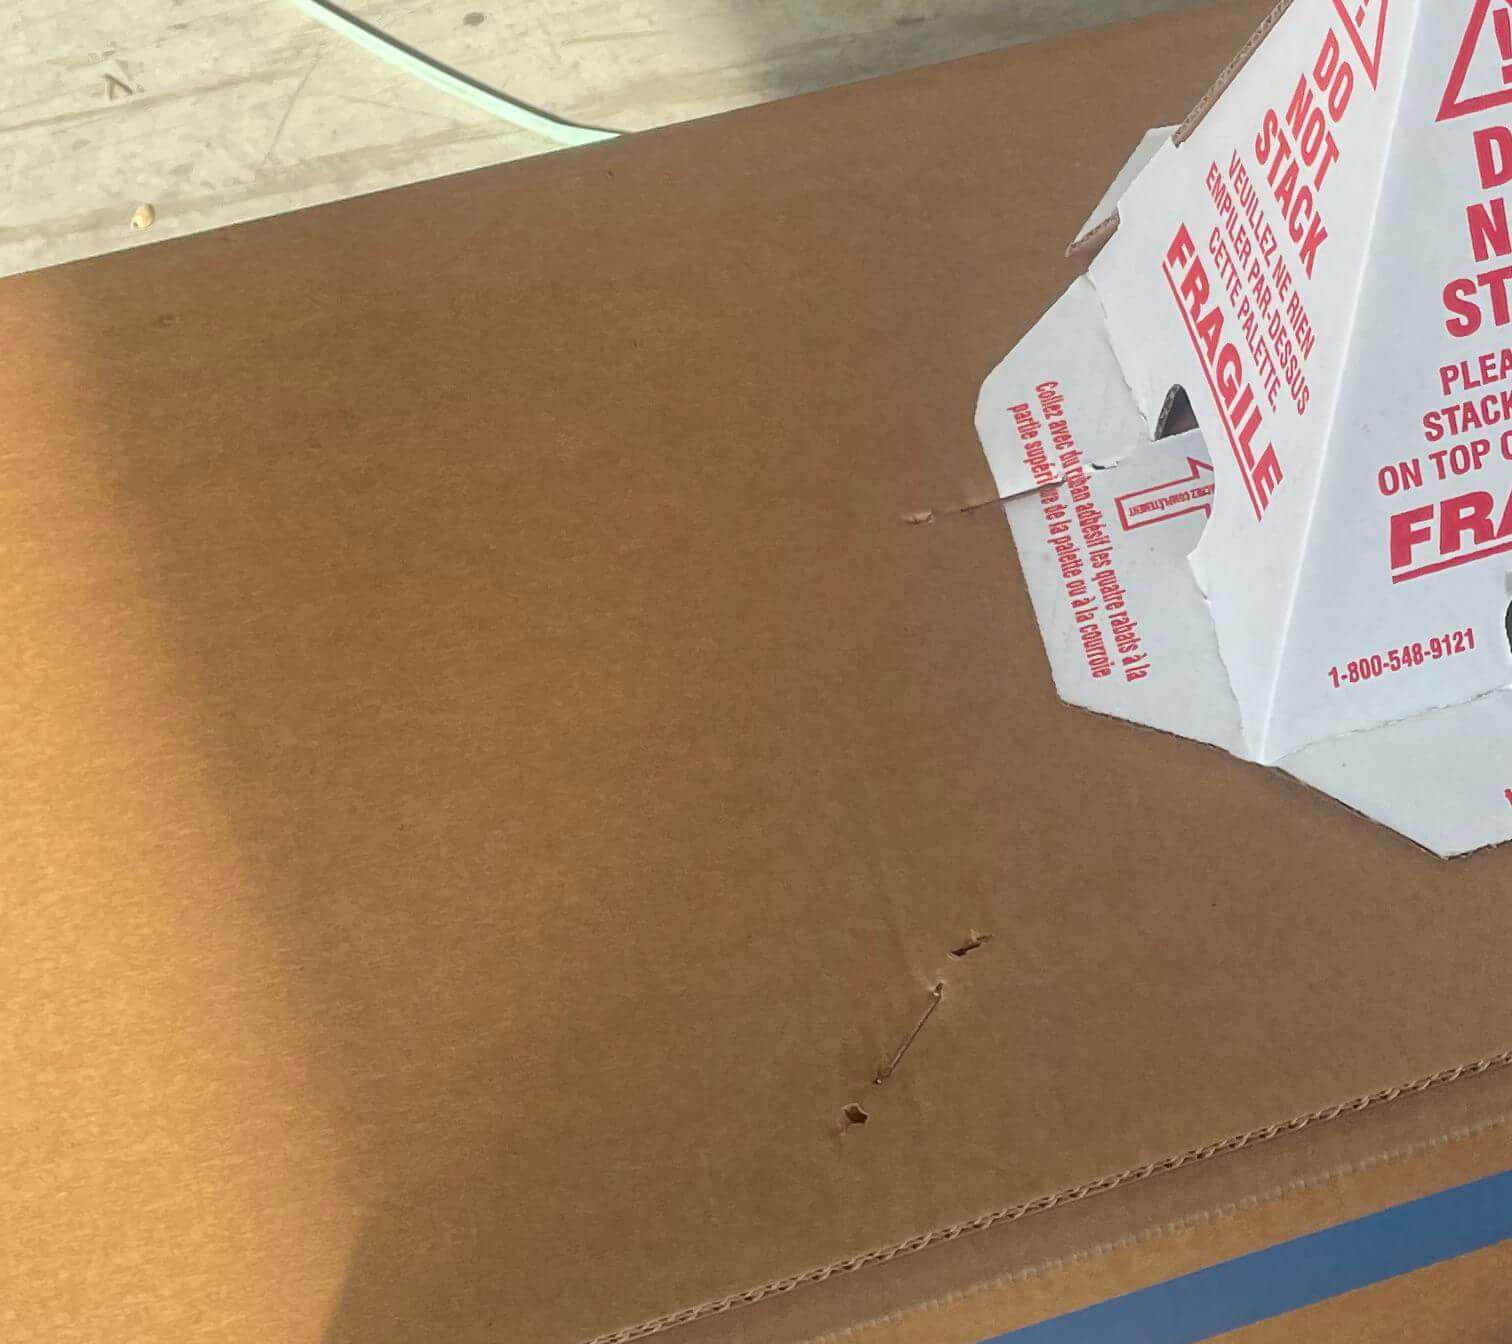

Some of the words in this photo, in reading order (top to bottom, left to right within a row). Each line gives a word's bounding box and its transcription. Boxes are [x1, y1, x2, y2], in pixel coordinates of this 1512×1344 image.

[1314, 31, 1353, 121] DO
[1286, 75, 1338, 188] NOT
[1255, 110, 1327, 276] STACK
[1230, 149, 1279, 264] VEUILLEZ
[1273, 261, 1291, 301] NE
[1289, 298, 1312, 357] RIEN
[1207, 158, 1251, 262] EMPILER
[1248, 261, 1309, 414] PAR-DESSUS
[1210, 228, 1240, 304] CETTE
[1239, 297, 1277, 410] PALETTE.
[1168, 221, 1283, 505] FRAGILE
[1036, 382, 1062, 418] Collez
[1009, 404, 1037, 438] partie
[1050, 421, 1072, 449] avec
[1059, 451, 1079, 466] du
[1378, 459, 1422, 495] ON
[1429, 440, 1489, 479] TOP
[1045, 504, 1064, 518] de
[1050, 522, 1067, 534] la
[1050, 536, 1081, 578] palette
[1091, 550, 1111, 568] les
[1067, 581, 1085, 595] ou
[1096, 570, 1124, 610] quatre
[1077, 607, 1097, 621] la
[1111, 612, 1138, 652] rabats
[1081, 624, 1110, 676] courroie
[1331, 628, 1473, 688] 1-800-548-9121
[1125, 664, 1150, 680] la
